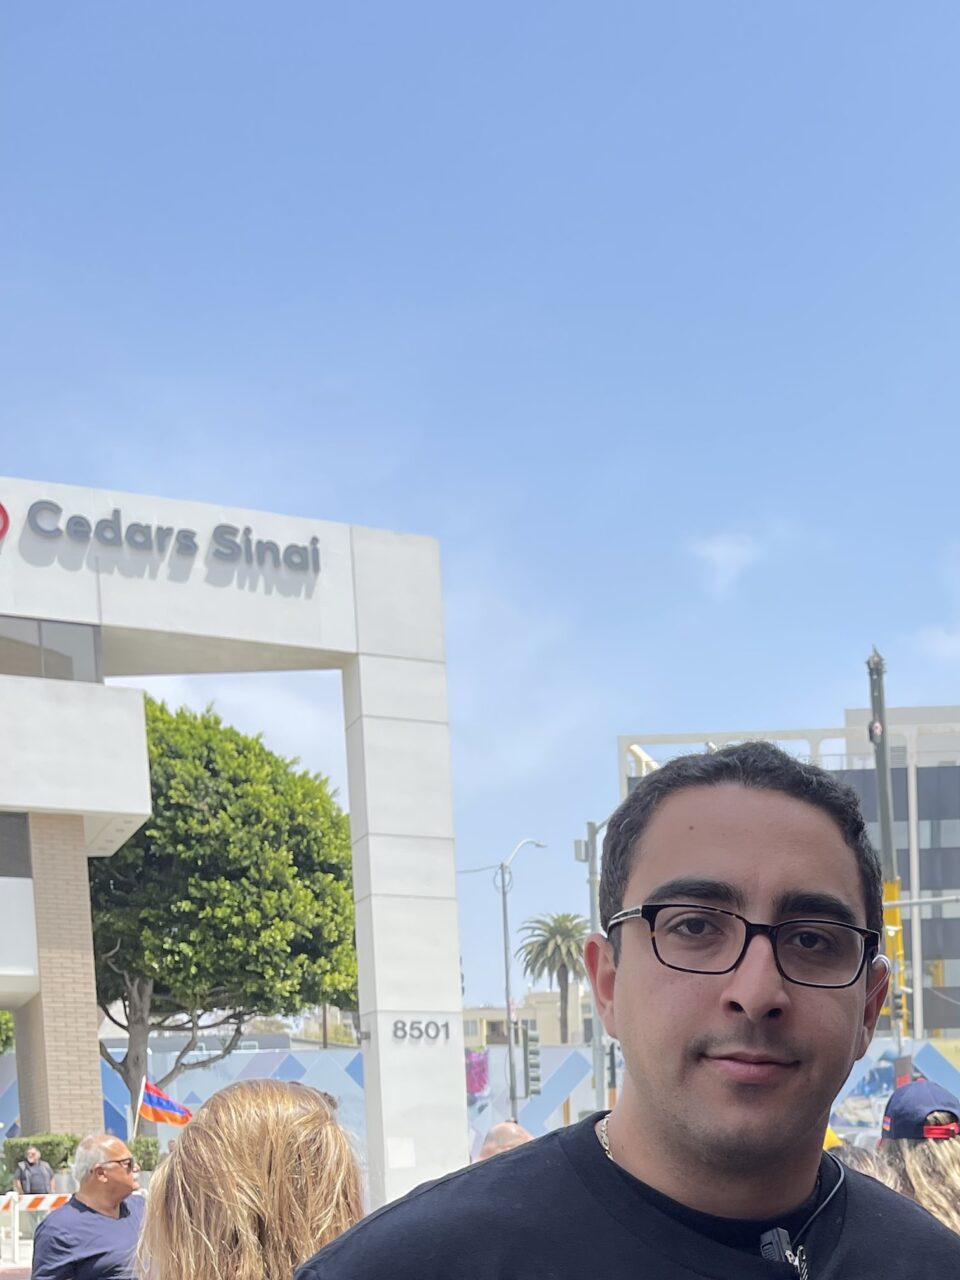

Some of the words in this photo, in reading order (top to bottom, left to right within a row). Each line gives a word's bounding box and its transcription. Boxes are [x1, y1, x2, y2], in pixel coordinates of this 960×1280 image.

[27, 500, 199, 556] Cedars
[212, 524, 321, 574] Sinai
[393, 1020, 450, 1040] 8501
